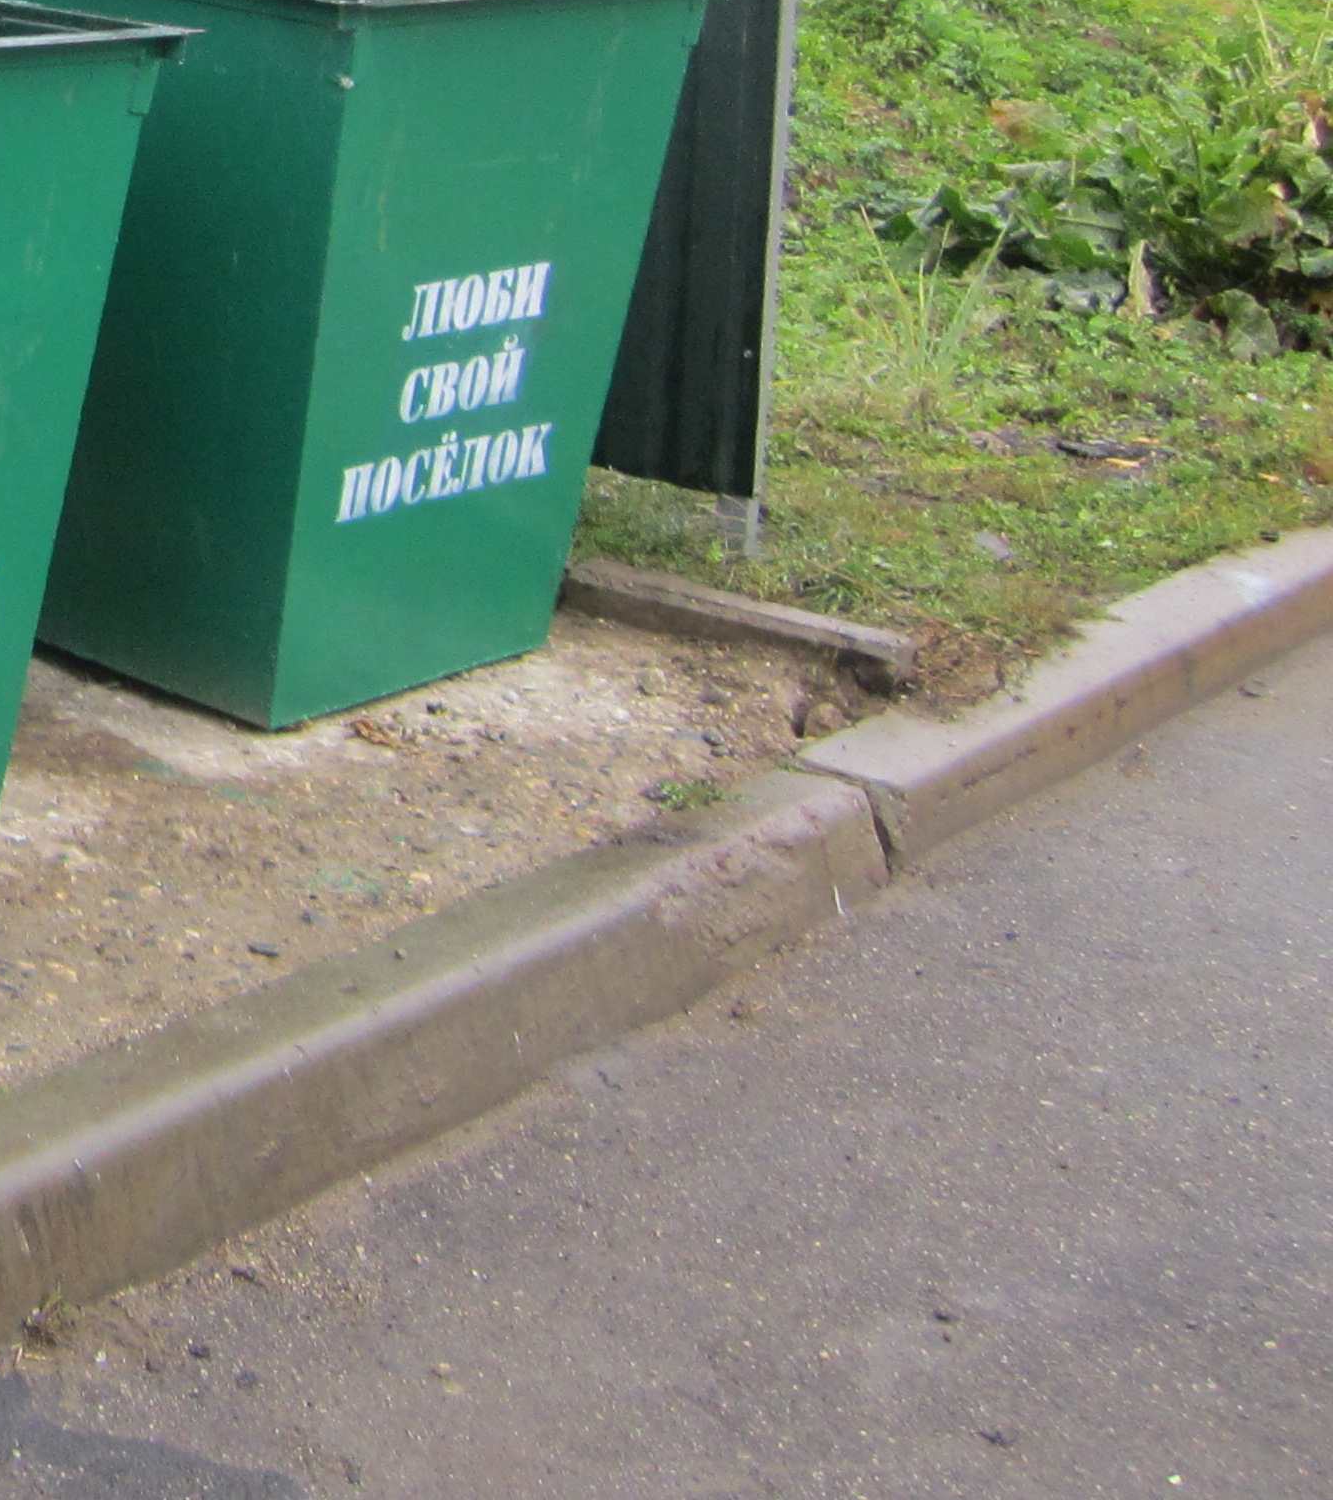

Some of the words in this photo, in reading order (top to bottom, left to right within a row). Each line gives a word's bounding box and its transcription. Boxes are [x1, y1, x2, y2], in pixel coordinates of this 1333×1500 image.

[401, 261, 552, 342] ЛЮБИ
[399, 333, 526, 424] СВОЙ
[336, 422, 553, 523] ПОСЁЛОК
